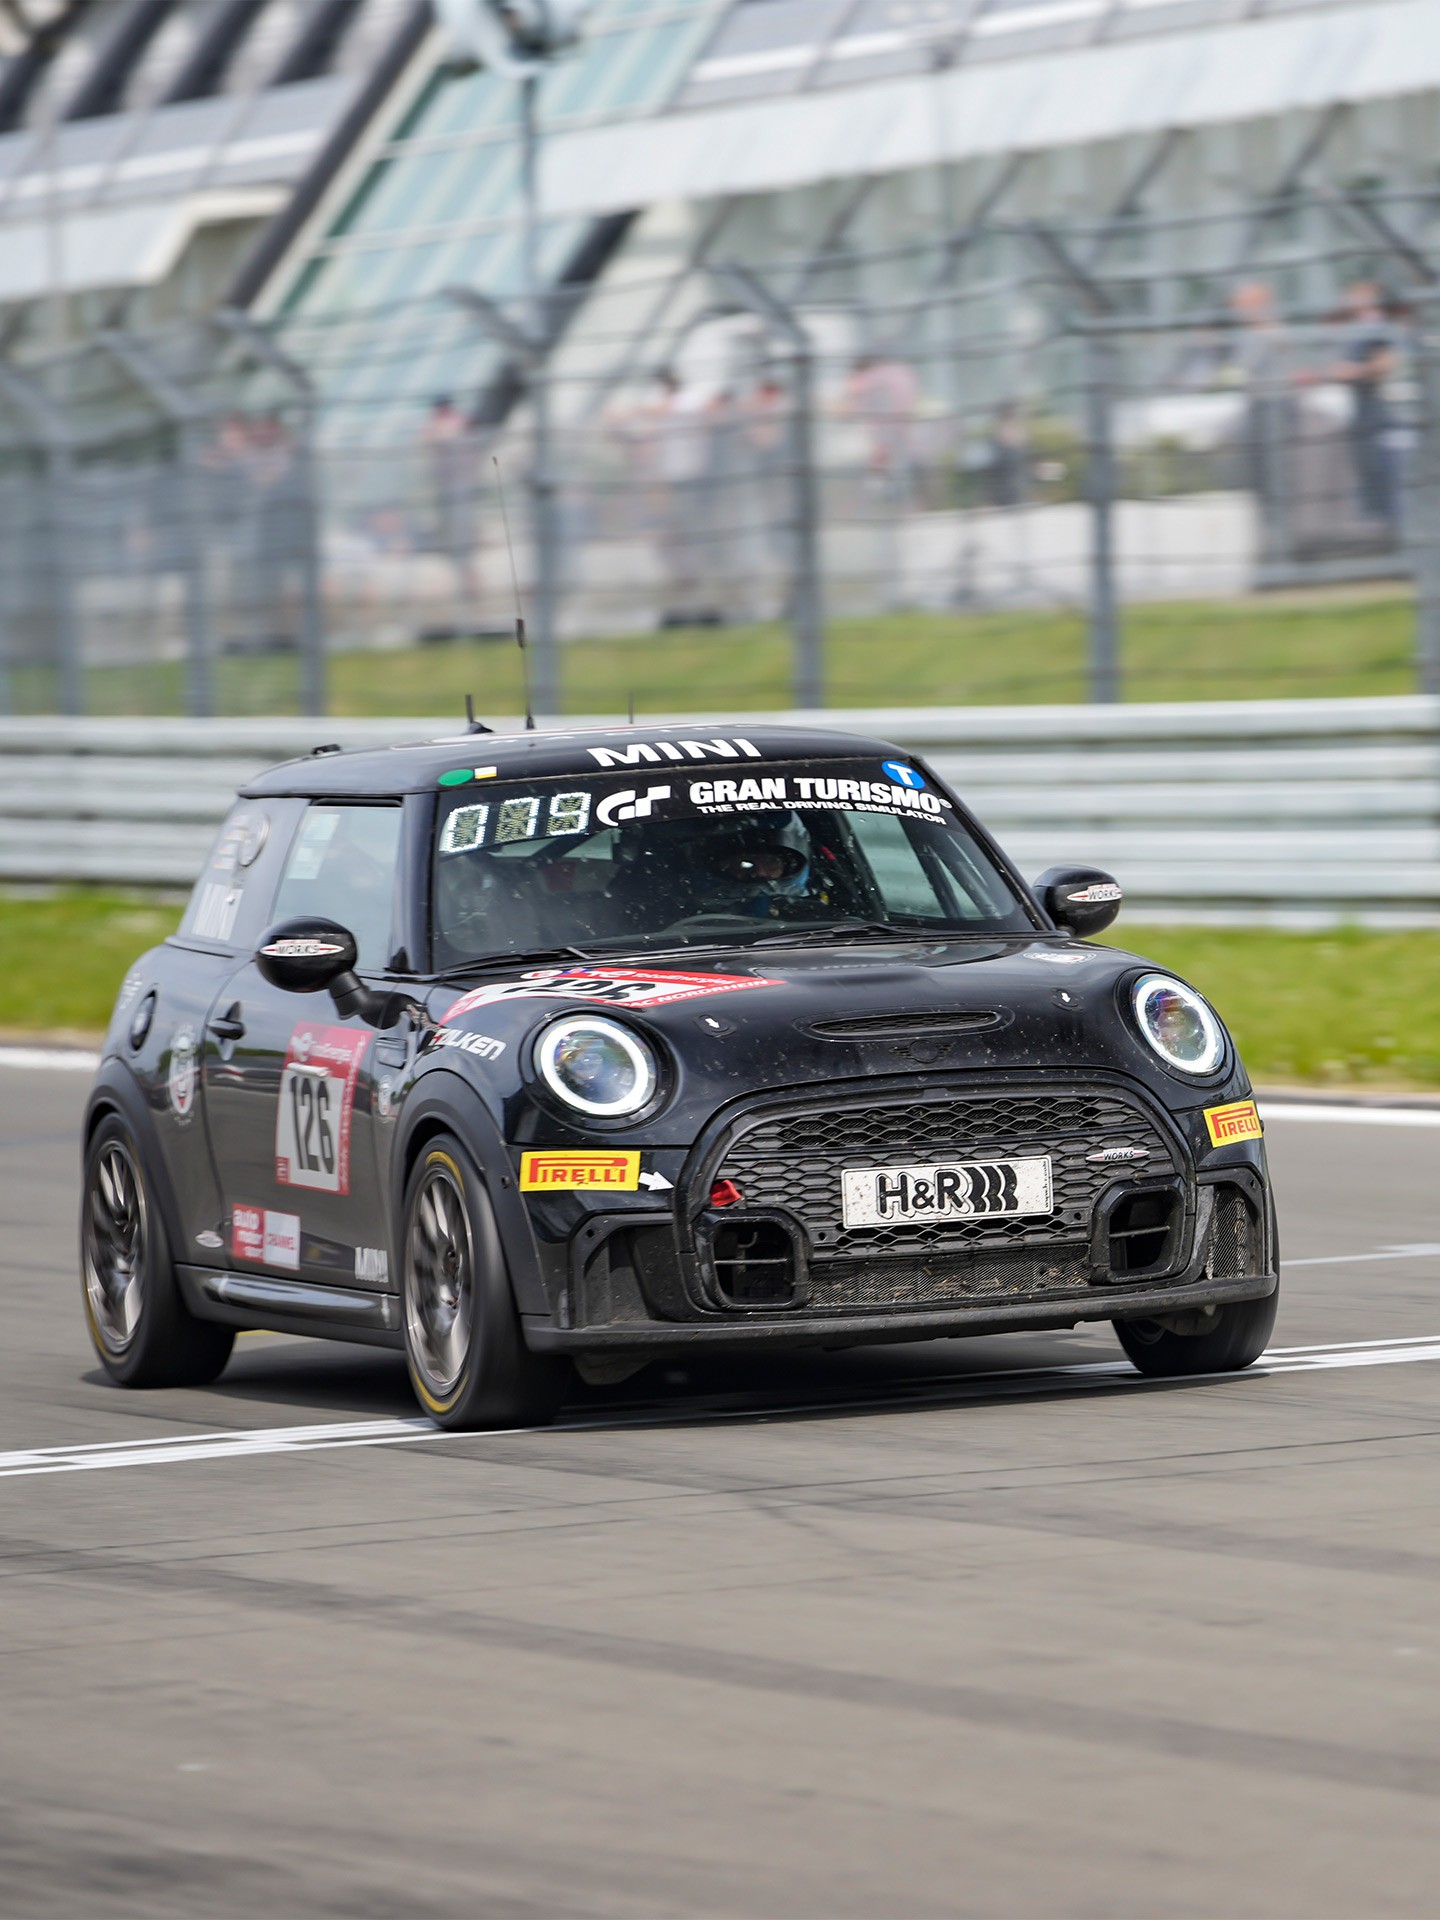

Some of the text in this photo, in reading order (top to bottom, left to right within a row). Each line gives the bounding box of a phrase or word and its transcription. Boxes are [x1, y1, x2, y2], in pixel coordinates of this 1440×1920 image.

[586, 738, 762, 767] MINI
[887, 763, 913, 786] T
[689, 777, 942, 814] GRAN TURISMO
[697, 801, 947, 825] THE REAL DRIVING SIMULATOR
[657, 979, 769, 1002] NORDRHEIN
[428, 1029, 507, 1061] FALKEN
[290, 1075, 335, 1175] 126
[1210, 1106, 1259, 1139] PIRELLI
[1104, 1150, 1134, 1160] WORKS
[529, 1157, 629, 1183] PIRELLI
[876, 1167, 972, 1220] H&R
[232, 1208, 260, 1231] auto
